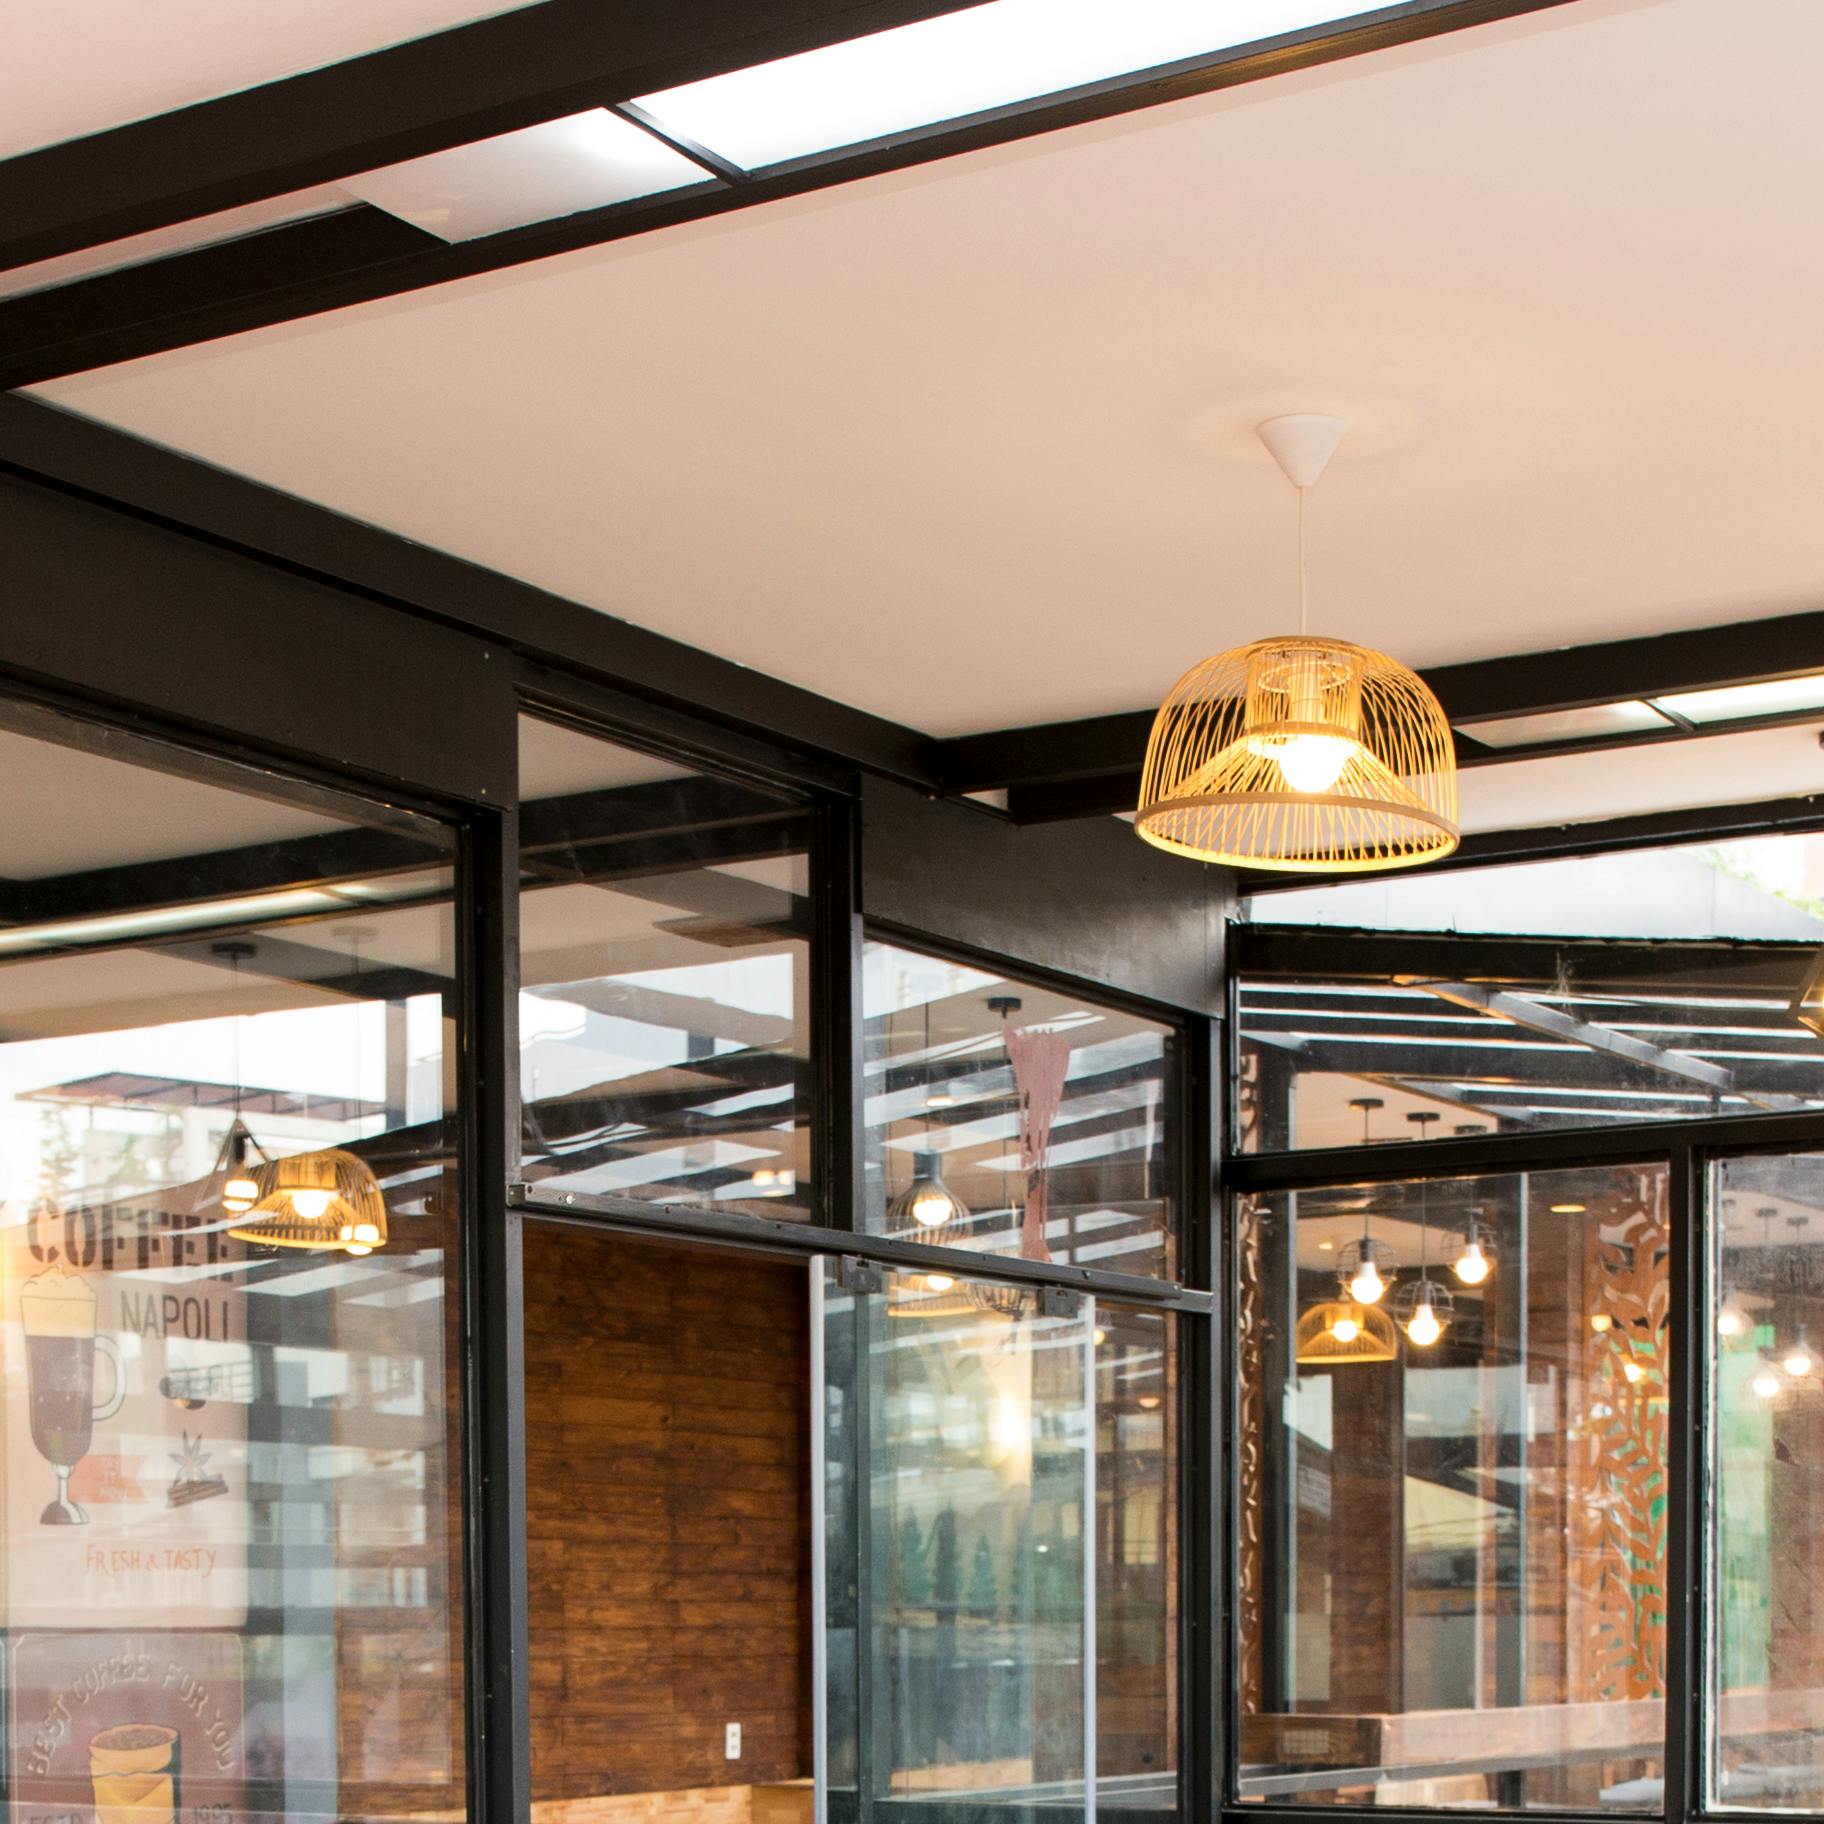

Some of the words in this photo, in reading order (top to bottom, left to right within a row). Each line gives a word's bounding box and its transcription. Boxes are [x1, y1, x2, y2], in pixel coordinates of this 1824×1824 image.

[121, 1290, 229, 1342] NAPOLI
[85, 1543, 141, 1577] FRESH
[164, 1547, 217, 1578] TASTY
[26, 1693, 72, 1776] BEST
